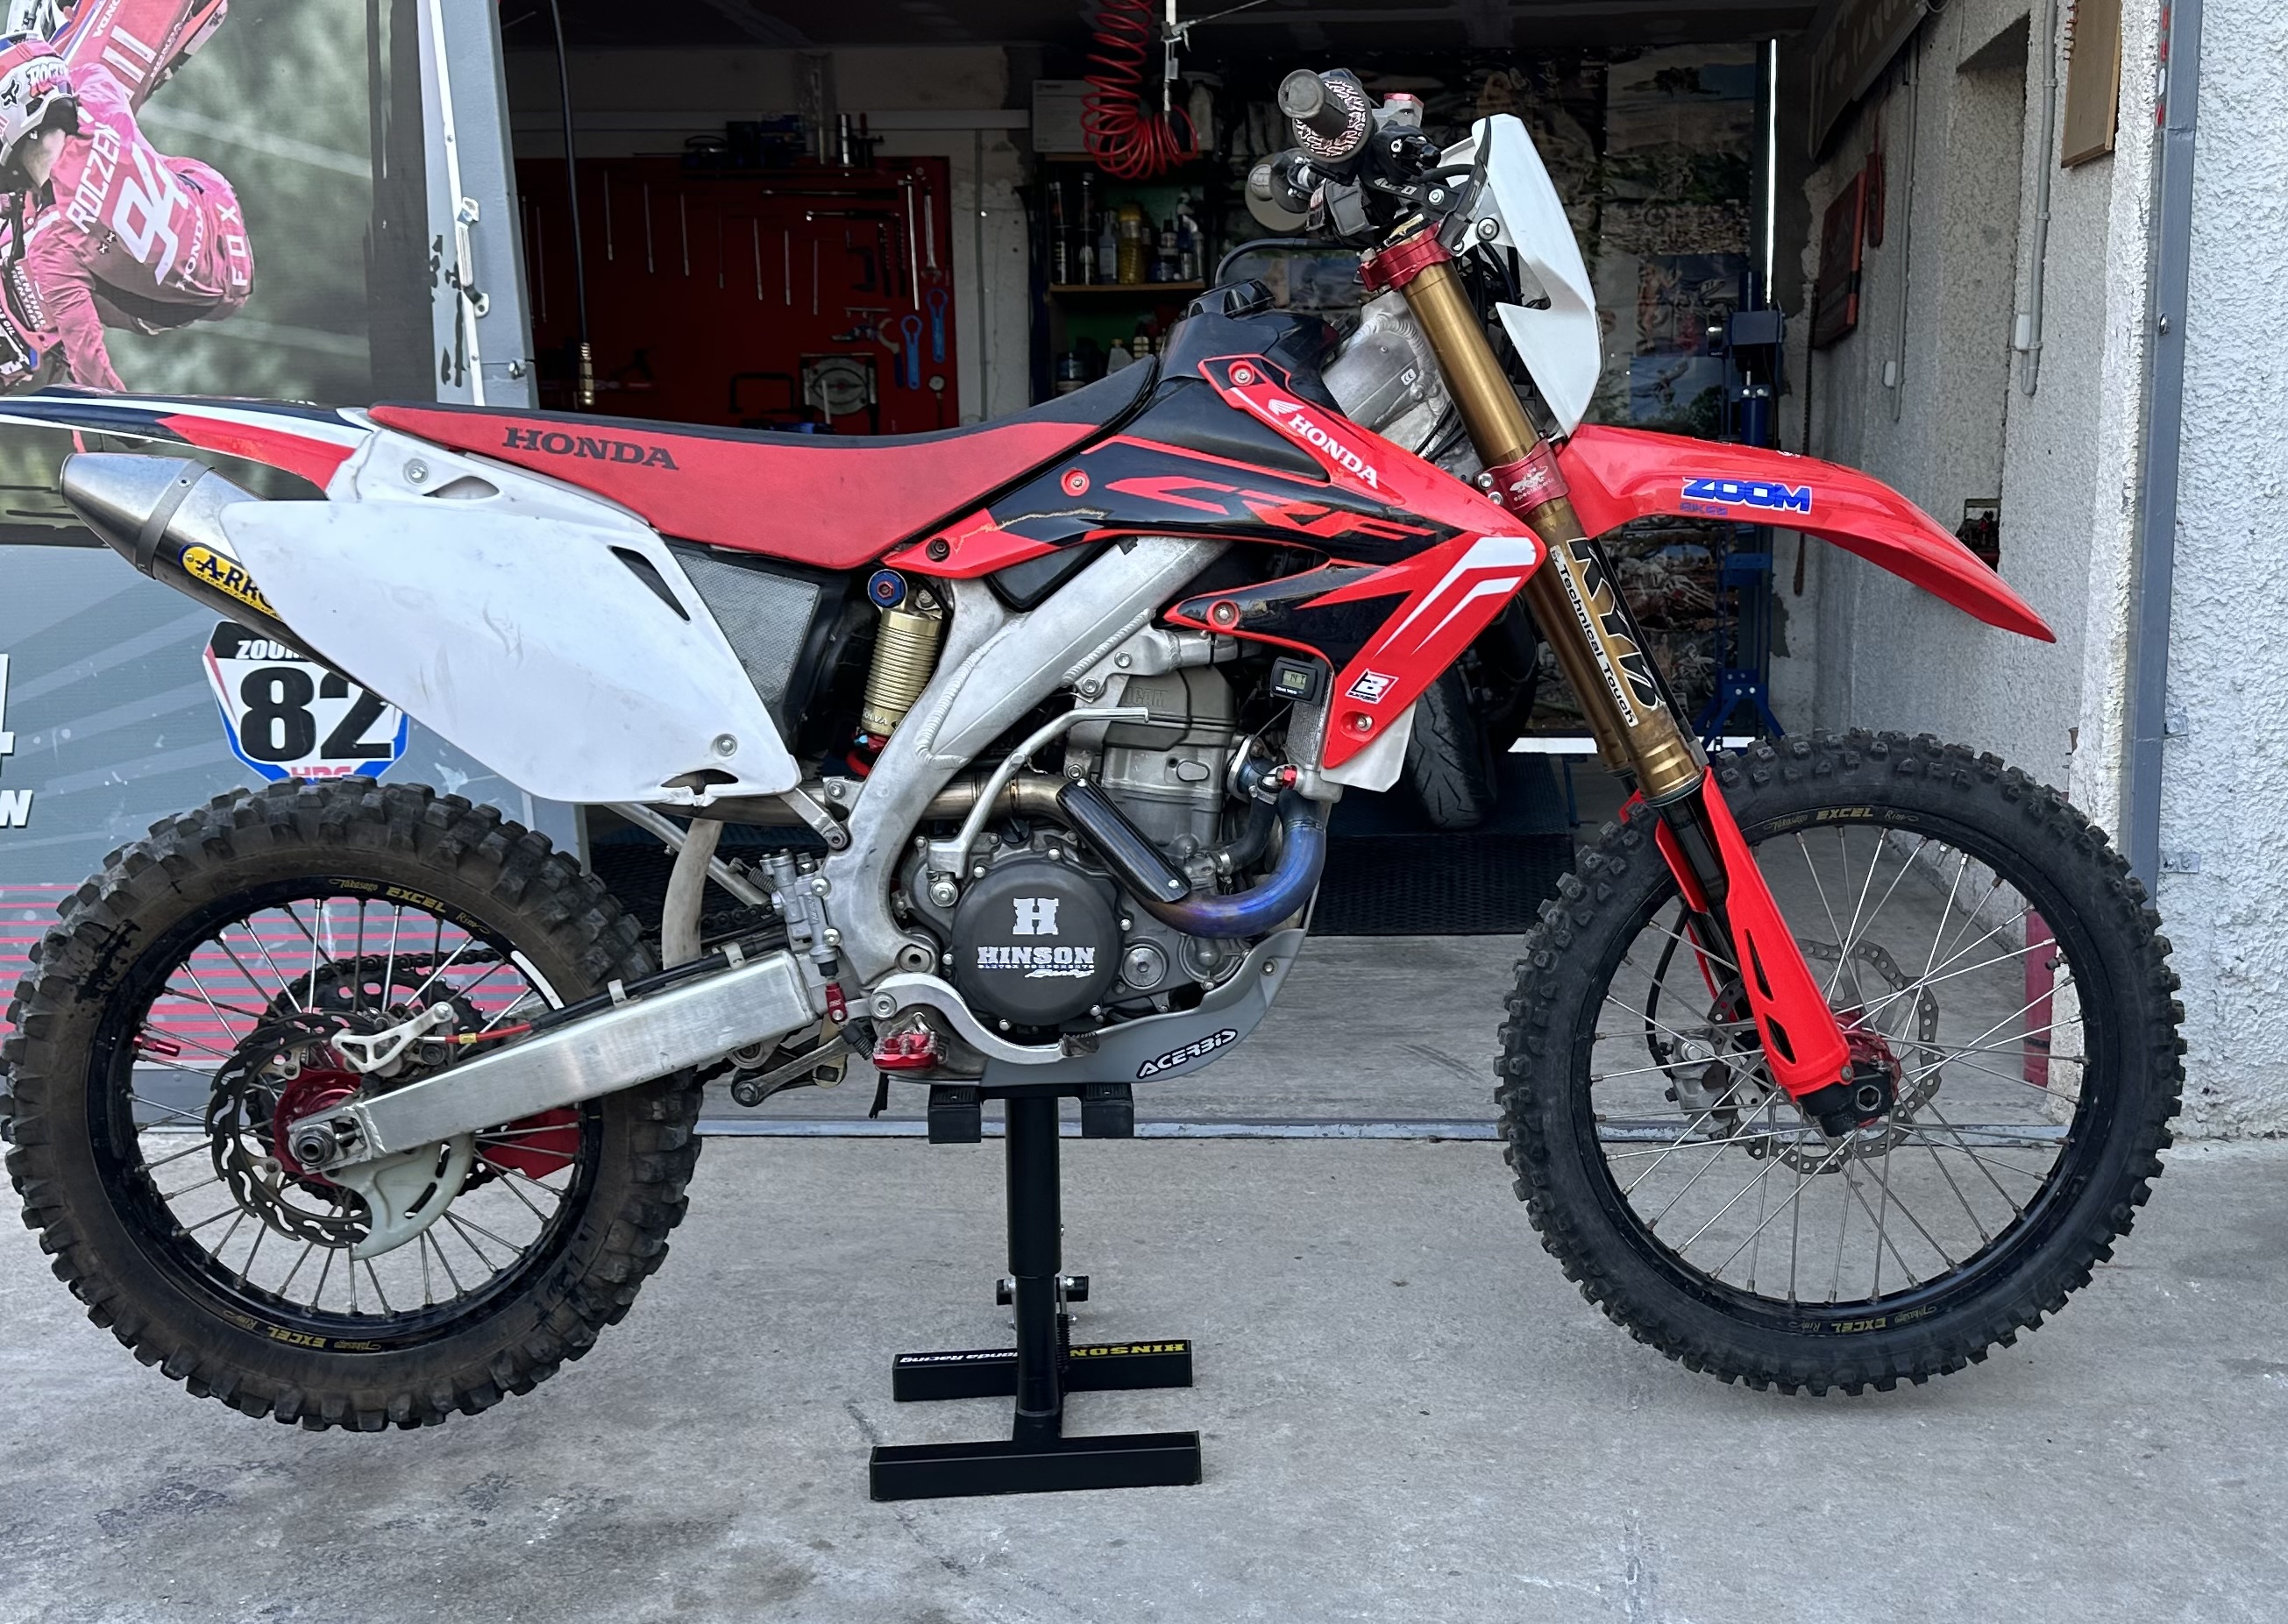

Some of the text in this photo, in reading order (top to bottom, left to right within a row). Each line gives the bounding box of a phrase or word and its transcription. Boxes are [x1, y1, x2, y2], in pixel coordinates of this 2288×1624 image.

[65, 121, 121, 234] ROCZEN
[216, 202, 248, 287] FOX
[501, 427, 679, 471] HONDA
[1288, 413, 1379, 490] HONDA
[1680, 477, 1812, 515] ZOOM
[1567, 537, 1666, 711] KYB
[1560, 564, 1604, 657] Technical
[1601, 663, 1634, 724] Touch
[240, 666, 392, 762] 82
[1815, 807, 1874, 821] EXCEL
[386, 886, 446, 913] EXCEL
[1013, 897, 1059, 935] H
[977, 946, 1096, 964] HINSON
[267, 1326, 327, 1349] EXCEL
[1830, 1317, 1887, 1333] EXCEL
[899, 1353, 963, 1364] Racing
[1069, 1343, 1186, 1358] HINSON
